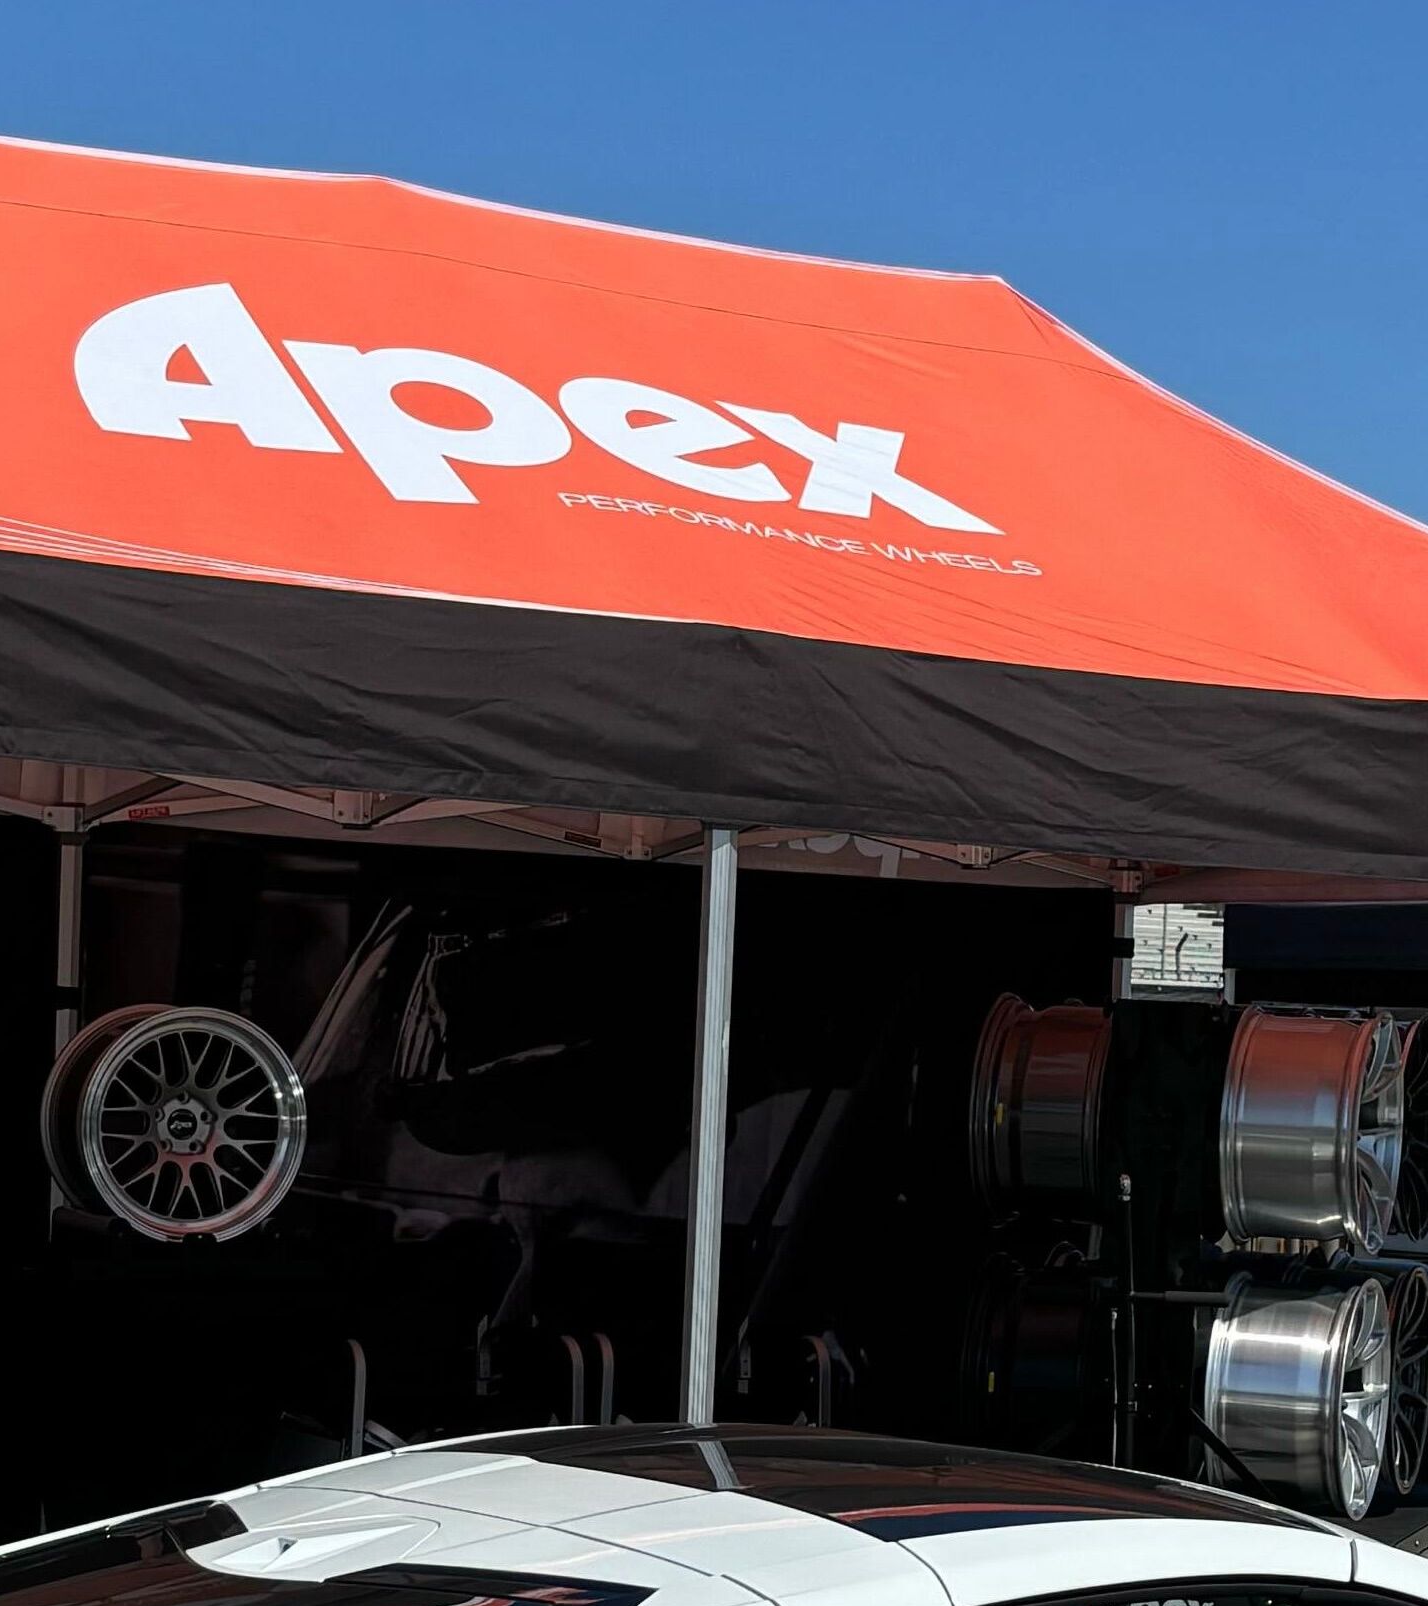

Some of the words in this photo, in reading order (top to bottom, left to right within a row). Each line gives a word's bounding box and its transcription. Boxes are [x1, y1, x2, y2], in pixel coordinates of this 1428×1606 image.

[74, 282, 1007, 535] Apex
[557, 491, 867, 557] PERFORMANCE
[873, 542, 1043, 577] WHEELS
